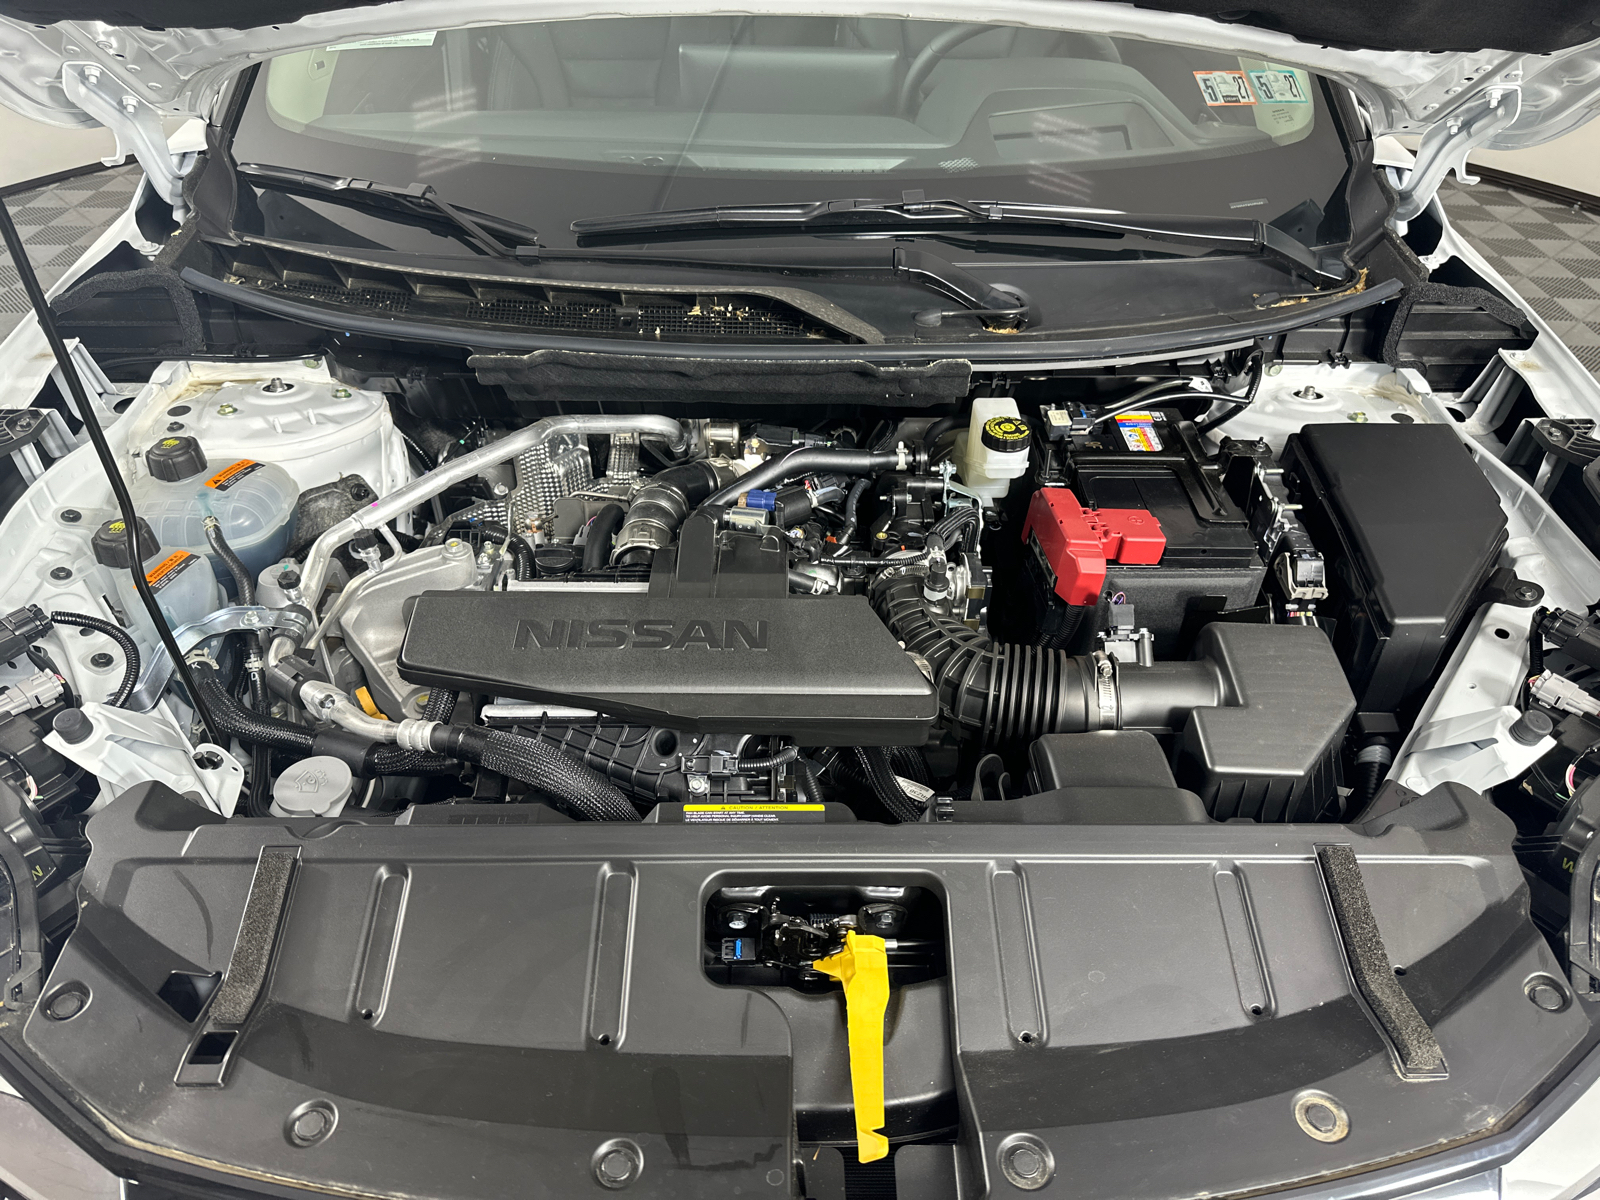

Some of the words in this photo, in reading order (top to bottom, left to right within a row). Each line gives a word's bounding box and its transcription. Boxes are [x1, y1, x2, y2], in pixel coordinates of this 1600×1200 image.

[1202, 79, 1218, 102] 5
[1232, 76, 1250, 101] 27
[1255, 76, 1273, 99] 5
[1284, 75, 1301, 99] 27
[513, 619, 768, 651] NISSAN
